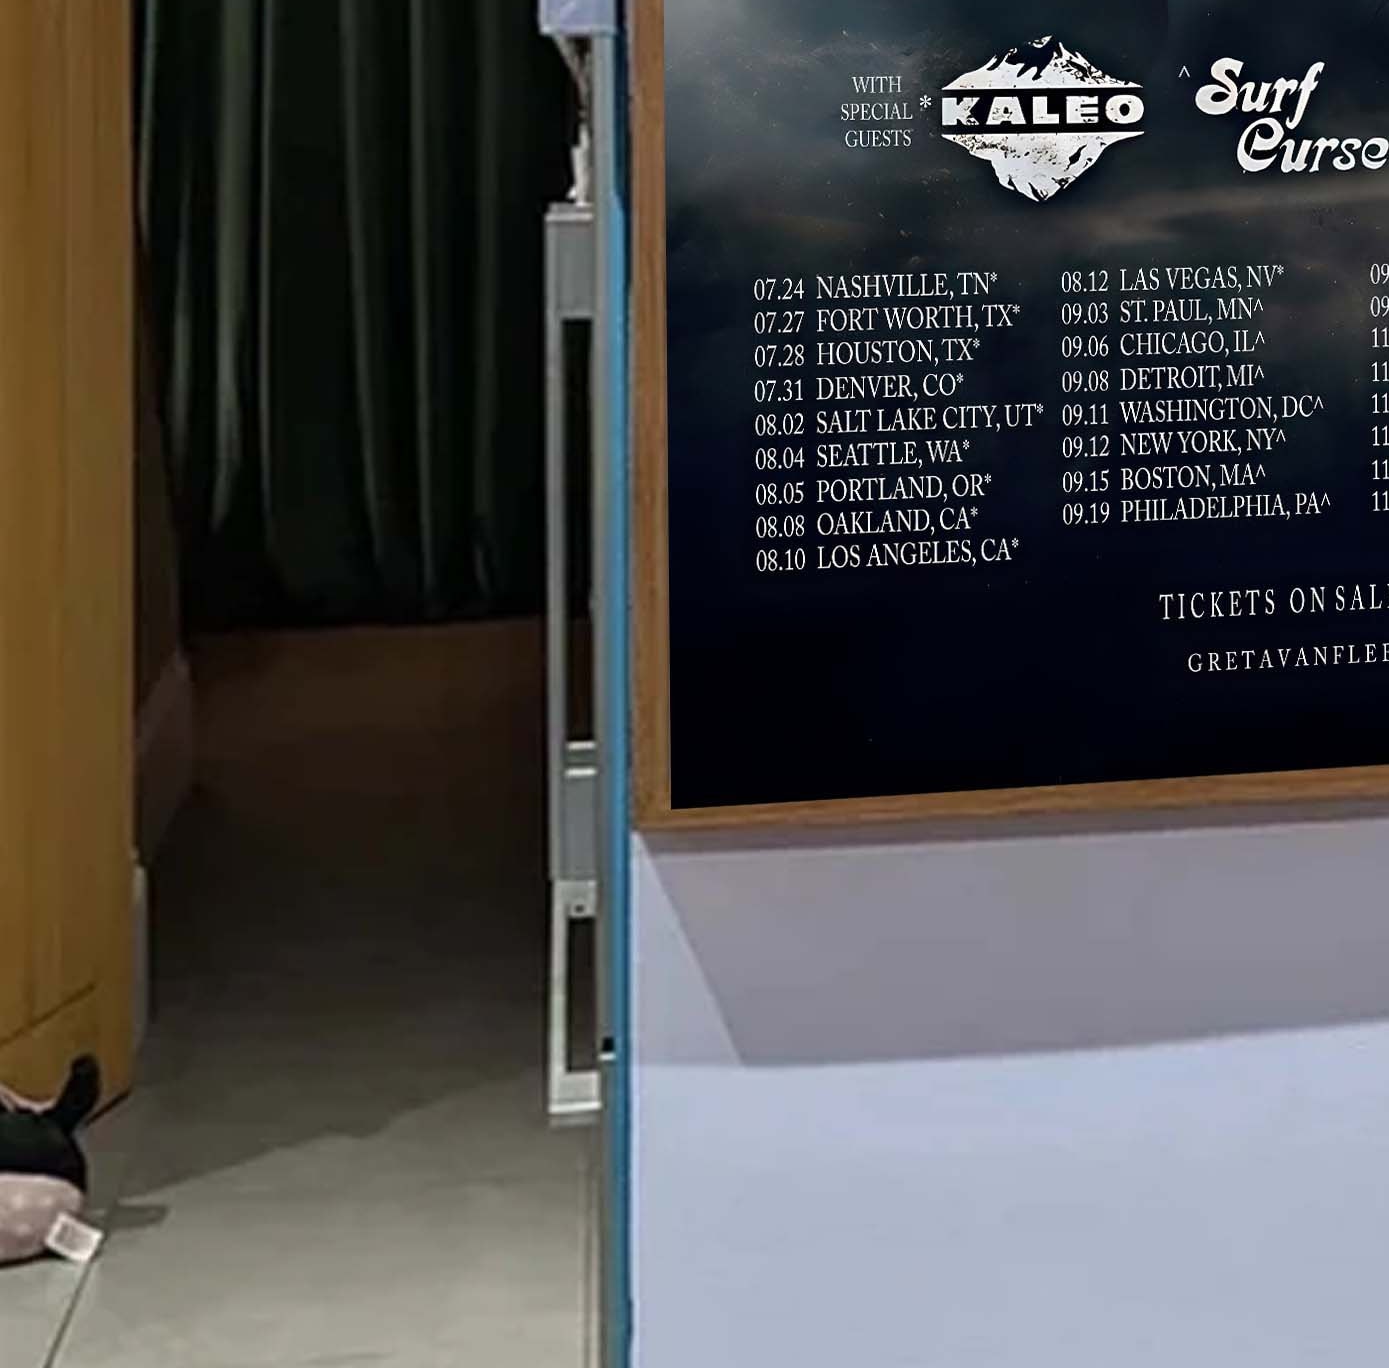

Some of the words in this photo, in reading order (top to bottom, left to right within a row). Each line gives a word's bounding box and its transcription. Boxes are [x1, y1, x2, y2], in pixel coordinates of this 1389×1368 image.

[851, 75, 902, 94] WITH
[1195, 58, 1325, 130] Surf
[840, 102, 913, 121] SPECIAL
[941, 94, 1144, 126] KALEO
[844, 129, 912, 148] GUESTS
[1236, 117, 1389, 172] Curse
[753, 277, 805, 301] 07.24
[816, 273, 954, 301] NASHVILLE,
[1061, 270, 1109, 293] 08.12
[1119, 267, 1160, 291] LAS
[1165, 265, 1242, 293] VEGAS,
[754, 310, 805, 335] 07.27
[816, 307, 879, 332] FORT
[882, 305, 979, 333] WORTH,
[1061, 302, 1109, 325] 09.03
[1120, 299, 1148, 324] ST.
[1152, 298, 1213, 325] PAUL,
[754, 343, 805, 368] 07.28
[816, 339, 939, 367] HOUSTON,
[1061, 334, 1109, 358] 09.06
[1120, 330, 1230, 357] CHICAGO,
[754, 379, 804, 403] 07.31
[815, 374, 918, 402] DENVER,
[1062, 369, 1109, 393] 09.08
[1119, 365, 1223, 392] DETROIT,
[754, 412, 805, 437] 08.02
[816, 408, 872, 434] SALT
[876, 407, 937, 432] LAKE
[942, 404, 1001, 432] CITY,
[1062, 403, 1109, 427] 09.11
[1119, 396, 1278, 424] WASHINGTON,
[755, 446, 805, 470] 08.04
[816, 441, 923, 469] SEATTLE,
[1062, 434, 1110, 458] 09.12
[1119, 431, 1174, 456] NEW
[1176, 429, 1242, 456] YORK,
[755, 481, 805, 506] 08.05
[816, 475, 948, 503] PORTLAND,
[1062, 469, 1110, 493] 09.15
[1120, 464, 1216, 492] BOSTON,
[755, 514, 805, 539] 08.08
[816, 508, 935, 536] OAKLAND,
[1062, 501, 1110, 526] 09.19
[1120, 493, 1291, 523] PHILADELPHIA,
[756, 547, 806, 572] 08.10
[817, 544, 861, 569] LOS
[865, 539, 977, 567] ANGELES,
[1159, 588, 1275, 620] TICKETS
